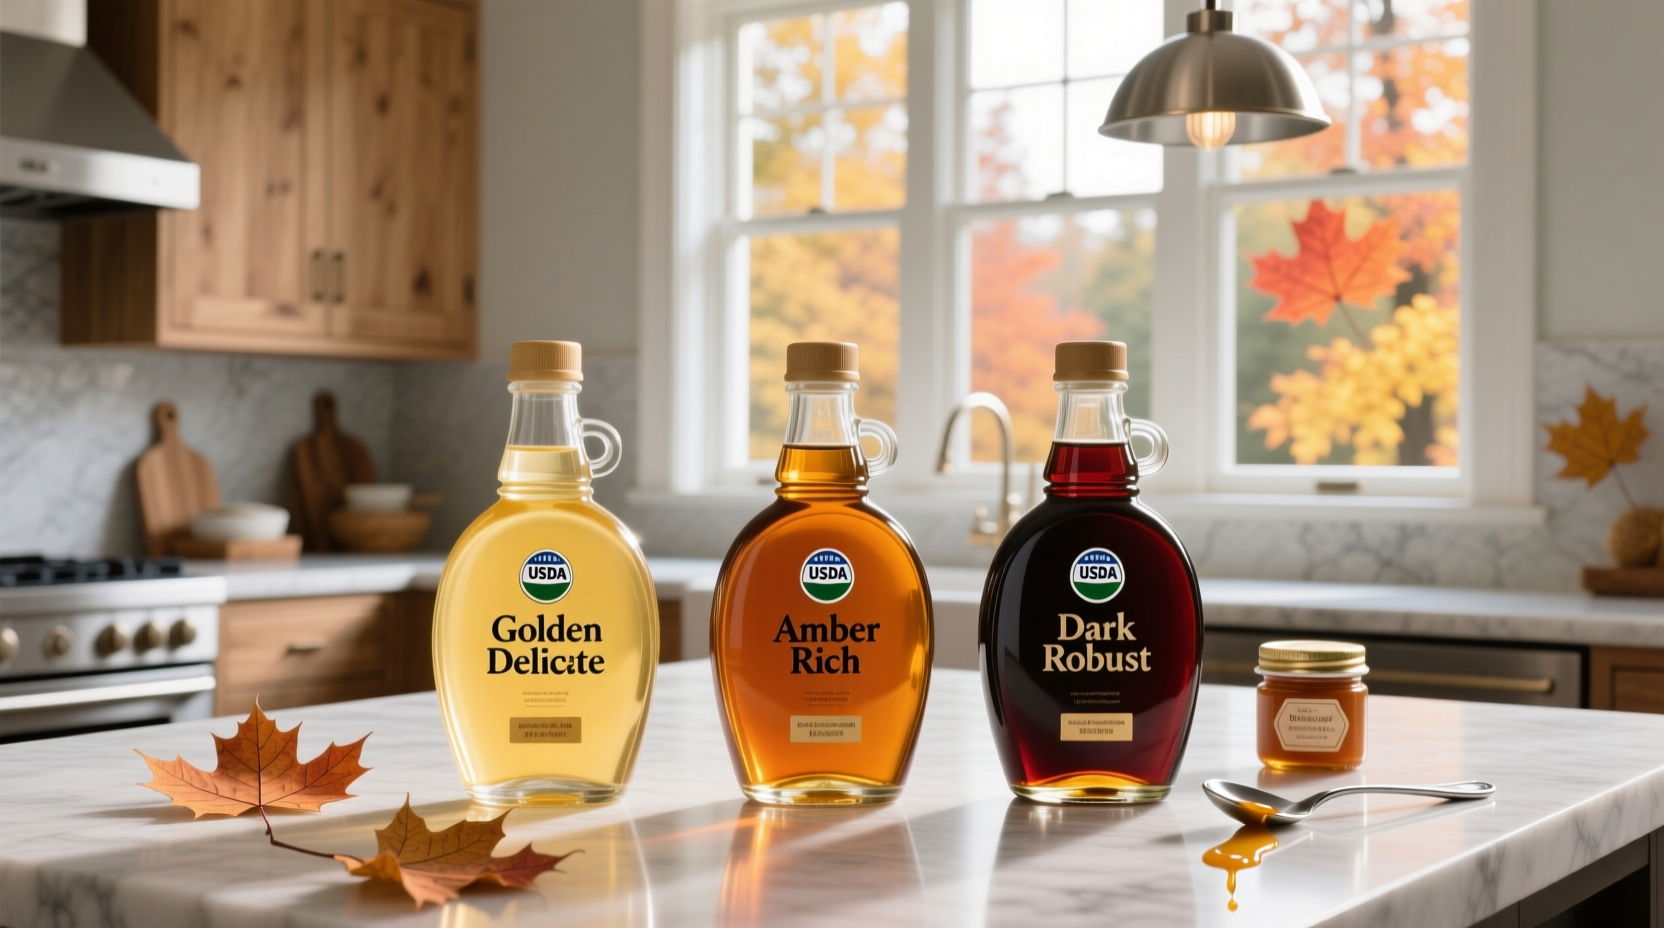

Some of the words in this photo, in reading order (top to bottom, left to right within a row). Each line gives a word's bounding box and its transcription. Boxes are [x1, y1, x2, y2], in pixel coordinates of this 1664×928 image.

[528, 566, 567, 580] USDA
[809, 566, 848, 580] USDA
[1080, 565, 1118, 580] USDA
[491, 613, 603, 643] Golden
[772, 613, 881, 643] Amber
[1057, 611, 1137, 641] Dark
[790, 645, 861, 675] Rich
[1042, 642, 1152, 672] Robust
